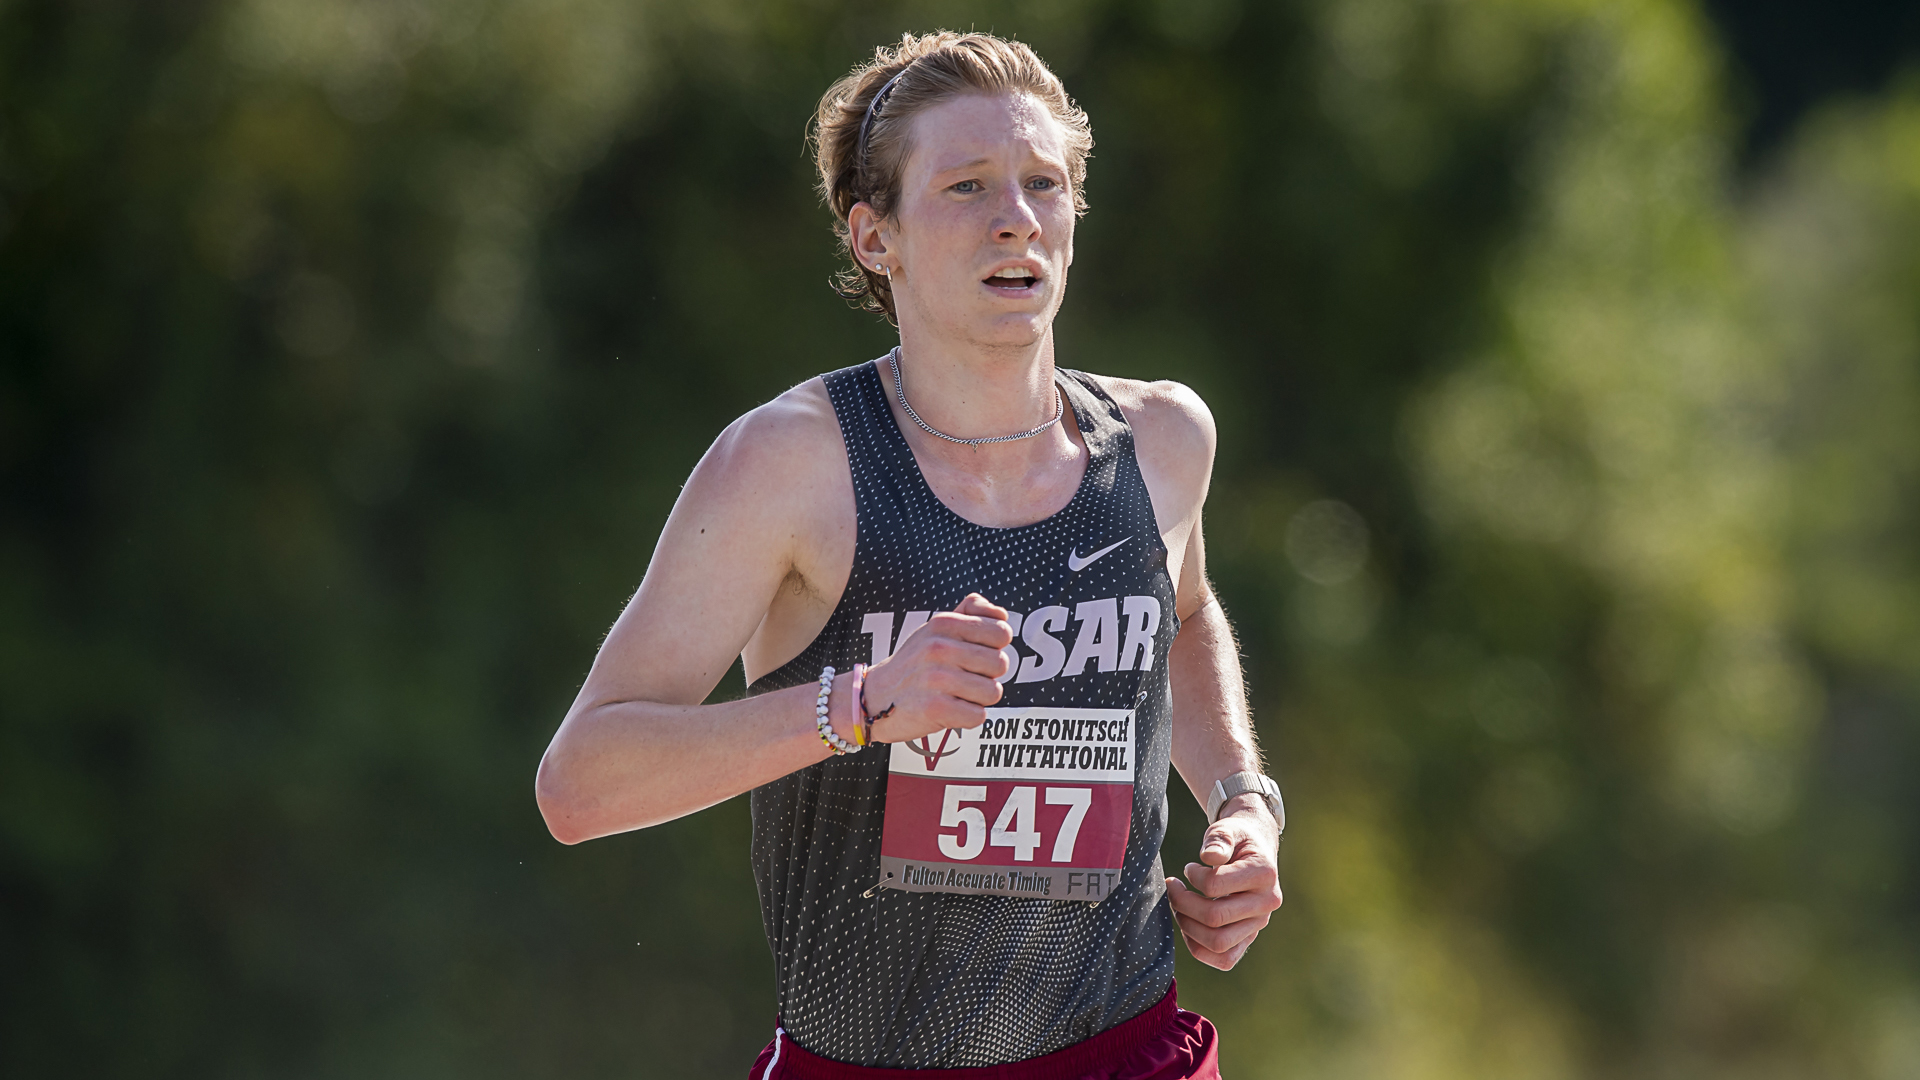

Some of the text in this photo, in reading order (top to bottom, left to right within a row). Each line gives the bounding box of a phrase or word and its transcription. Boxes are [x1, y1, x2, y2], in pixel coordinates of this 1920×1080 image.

[861, 596, 1160, 684] VSAR
[979, 718, 1128, 742] RON STONITSCH
[976, 744, 1128, 771] INVITATIONAL
[937, 784, 1092, 863] 547
[902, 864, 1116, 896] Fulton Accurate Timing FAT
